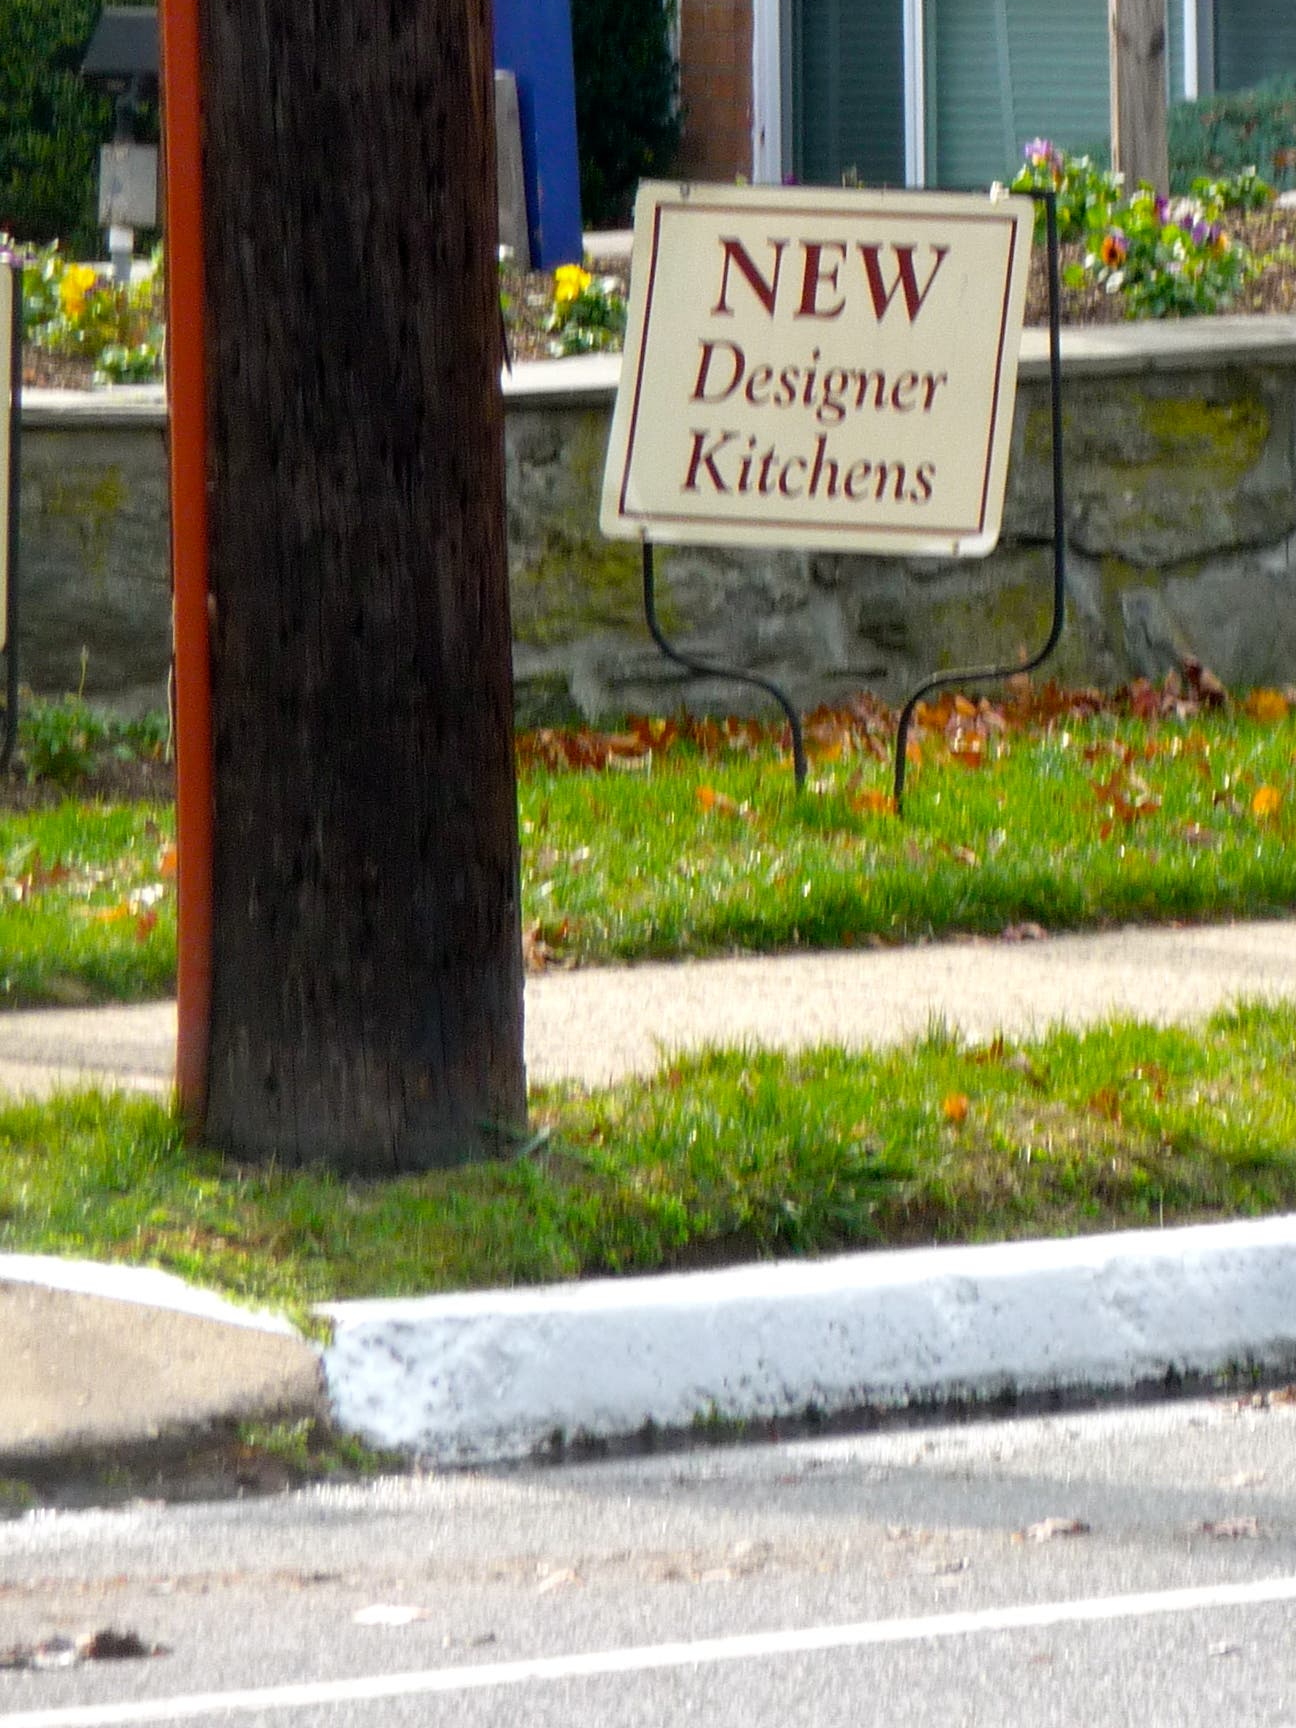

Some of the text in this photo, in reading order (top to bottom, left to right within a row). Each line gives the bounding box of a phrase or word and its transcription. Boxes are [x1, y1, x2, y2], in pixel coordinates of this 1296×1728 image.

[711, 235, 951, 325] NEW
[689, 337, 948, 427] Designer
[680, 427, 937, 505] Kitchens
